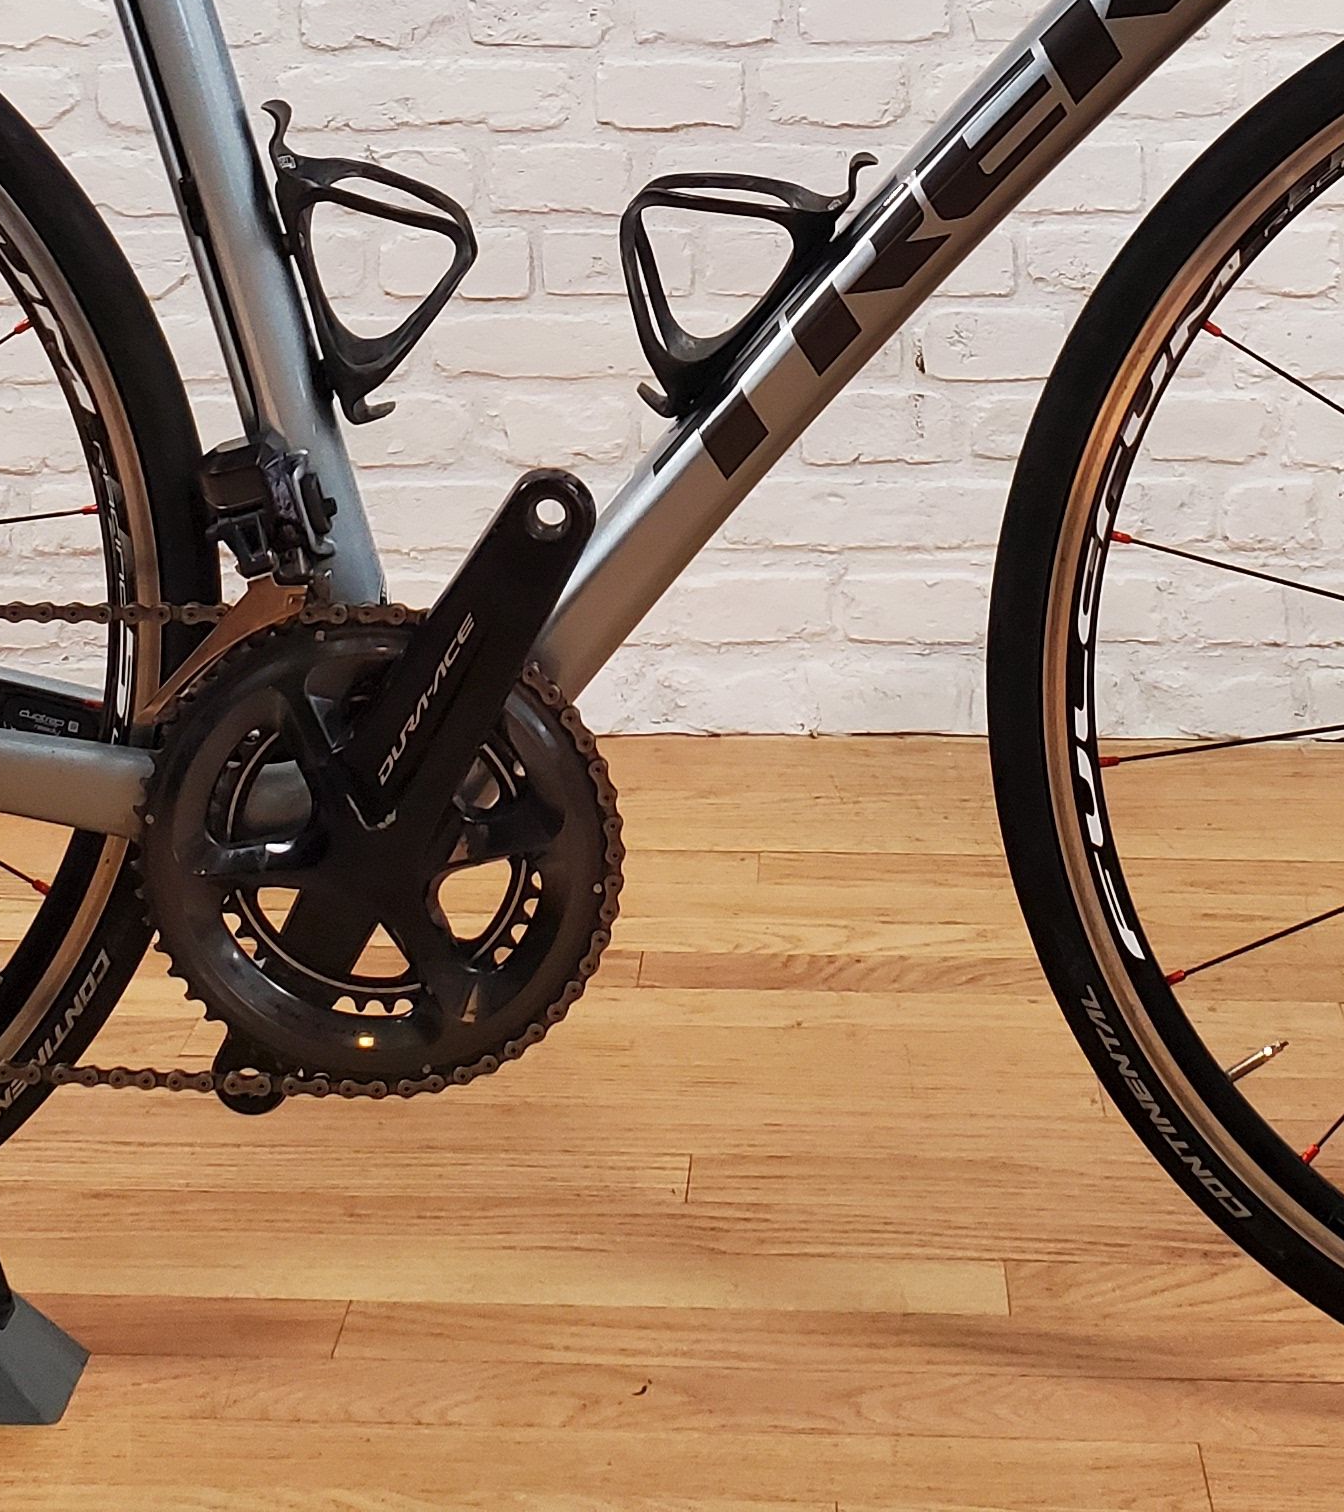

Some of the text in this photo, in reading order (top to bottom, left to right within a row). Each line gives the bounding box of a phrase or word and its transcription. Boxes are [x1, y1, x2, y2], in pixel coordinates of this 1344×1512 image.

[377, 611, 475, 787] DURA-ACE
[1074, 249, 1241, 961] FULCRUM
[1080, 984, 1254, 1219] CONTINENTAL
